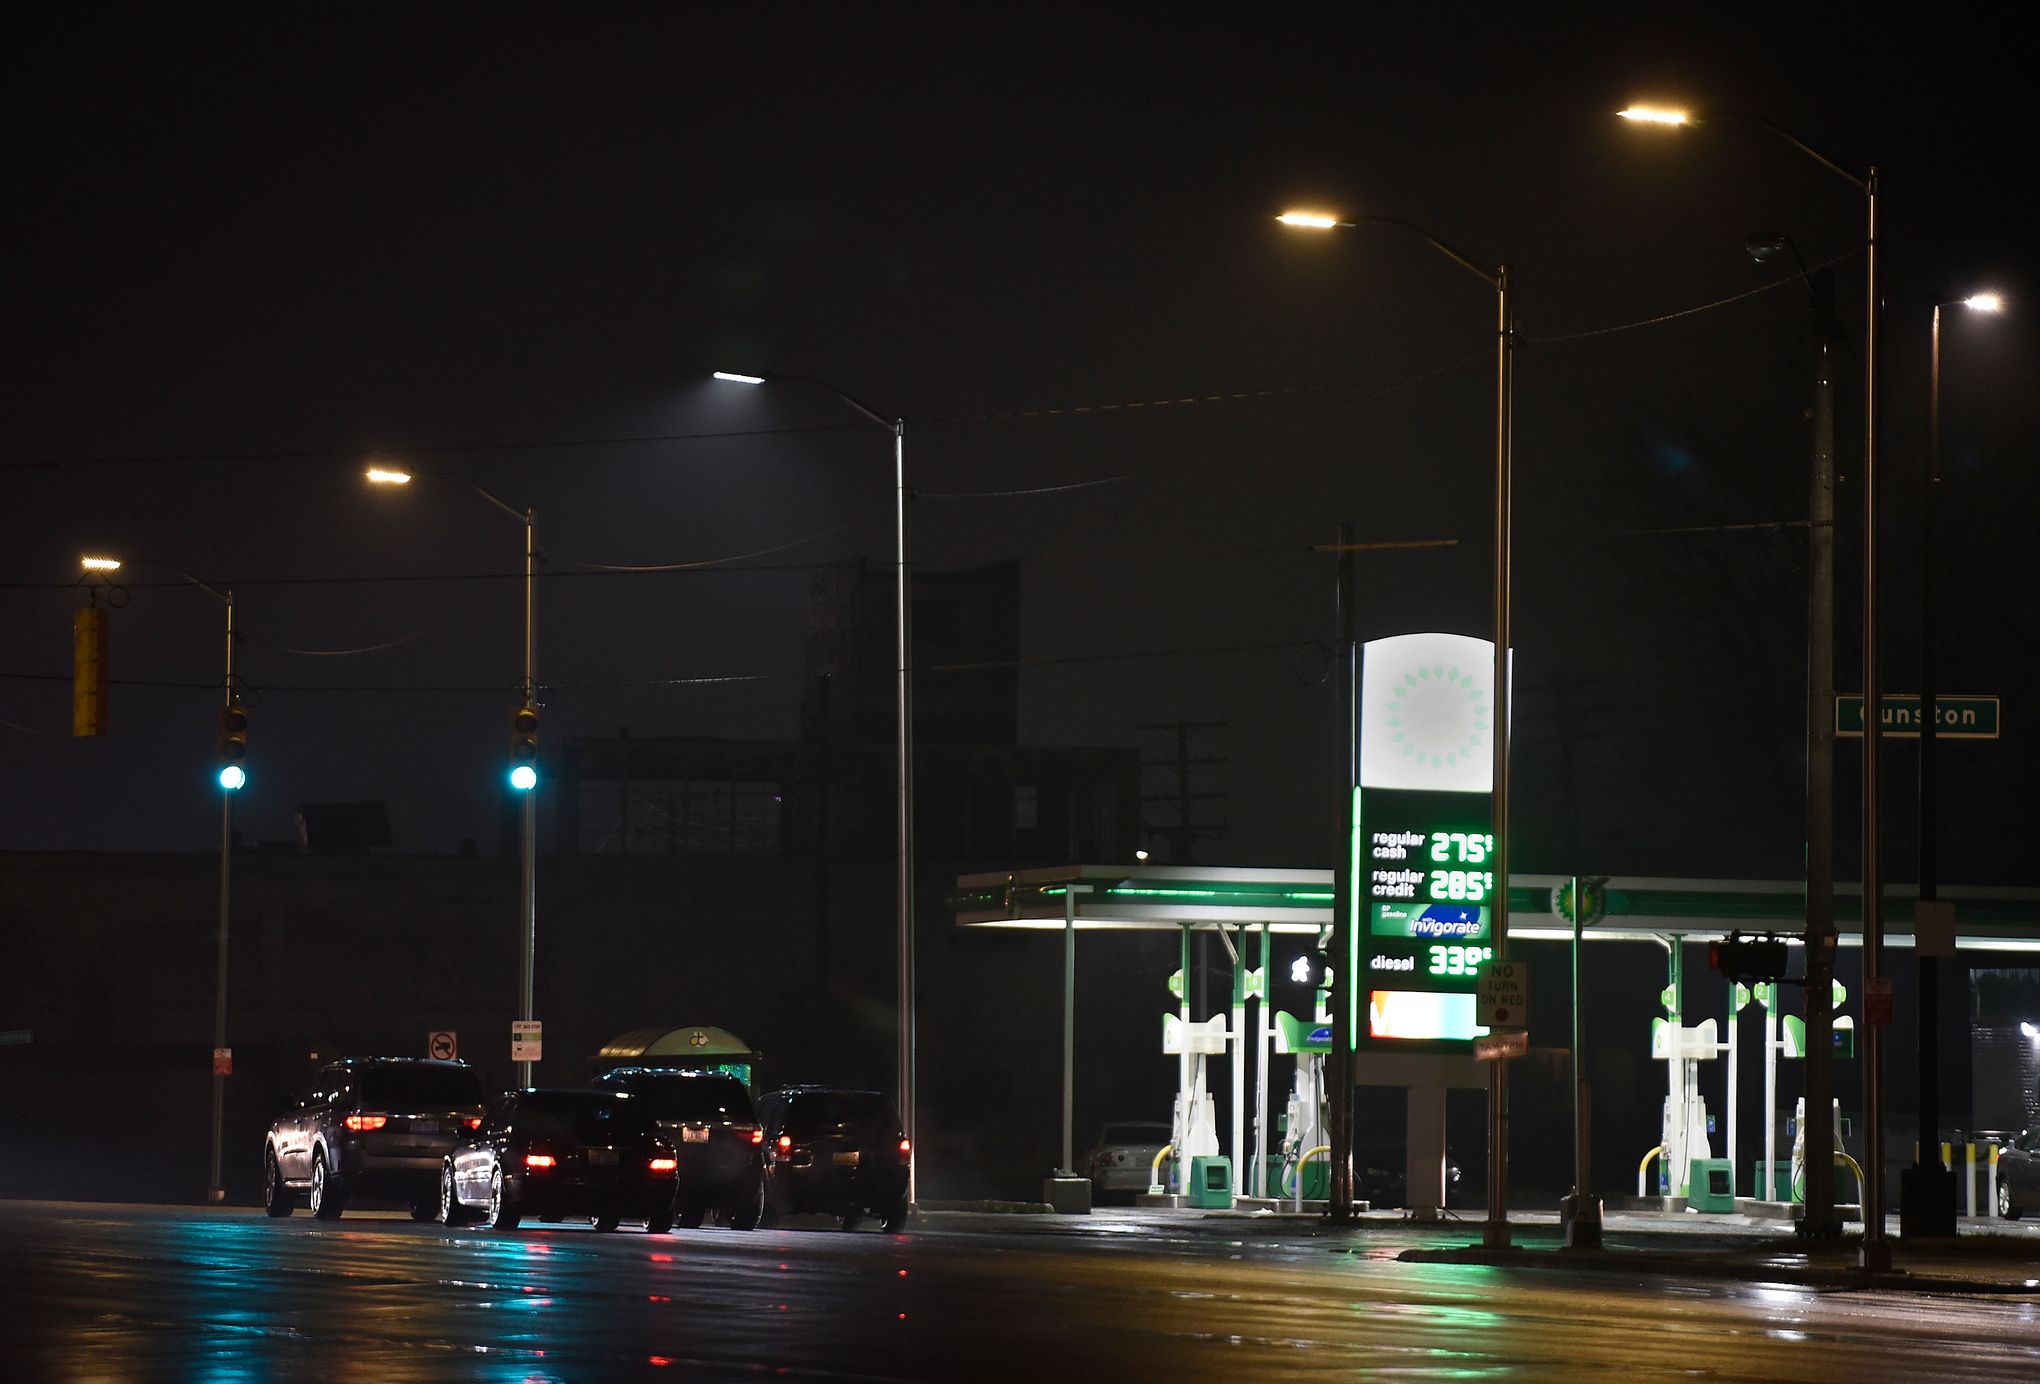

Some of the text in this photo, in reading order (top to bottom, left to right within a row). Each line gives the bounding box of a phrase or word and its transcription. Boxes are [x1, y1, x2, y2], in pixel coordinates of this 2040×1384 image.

[1374, 832, 1425, 847] regular
[1374, 846, 1407, 859] cash
[1373, 869, 1424, 884] regular
[1373, 883, 1415, 897] credit
[1410, 918, 1480, 936] Invigorate
[1371, 955, 1414, 971] diesel
[1491, 964, 1514, 978] NO
[1488, 981, 1518, 992] TURN
[1481, 994, 1524, 1006] ON RED
